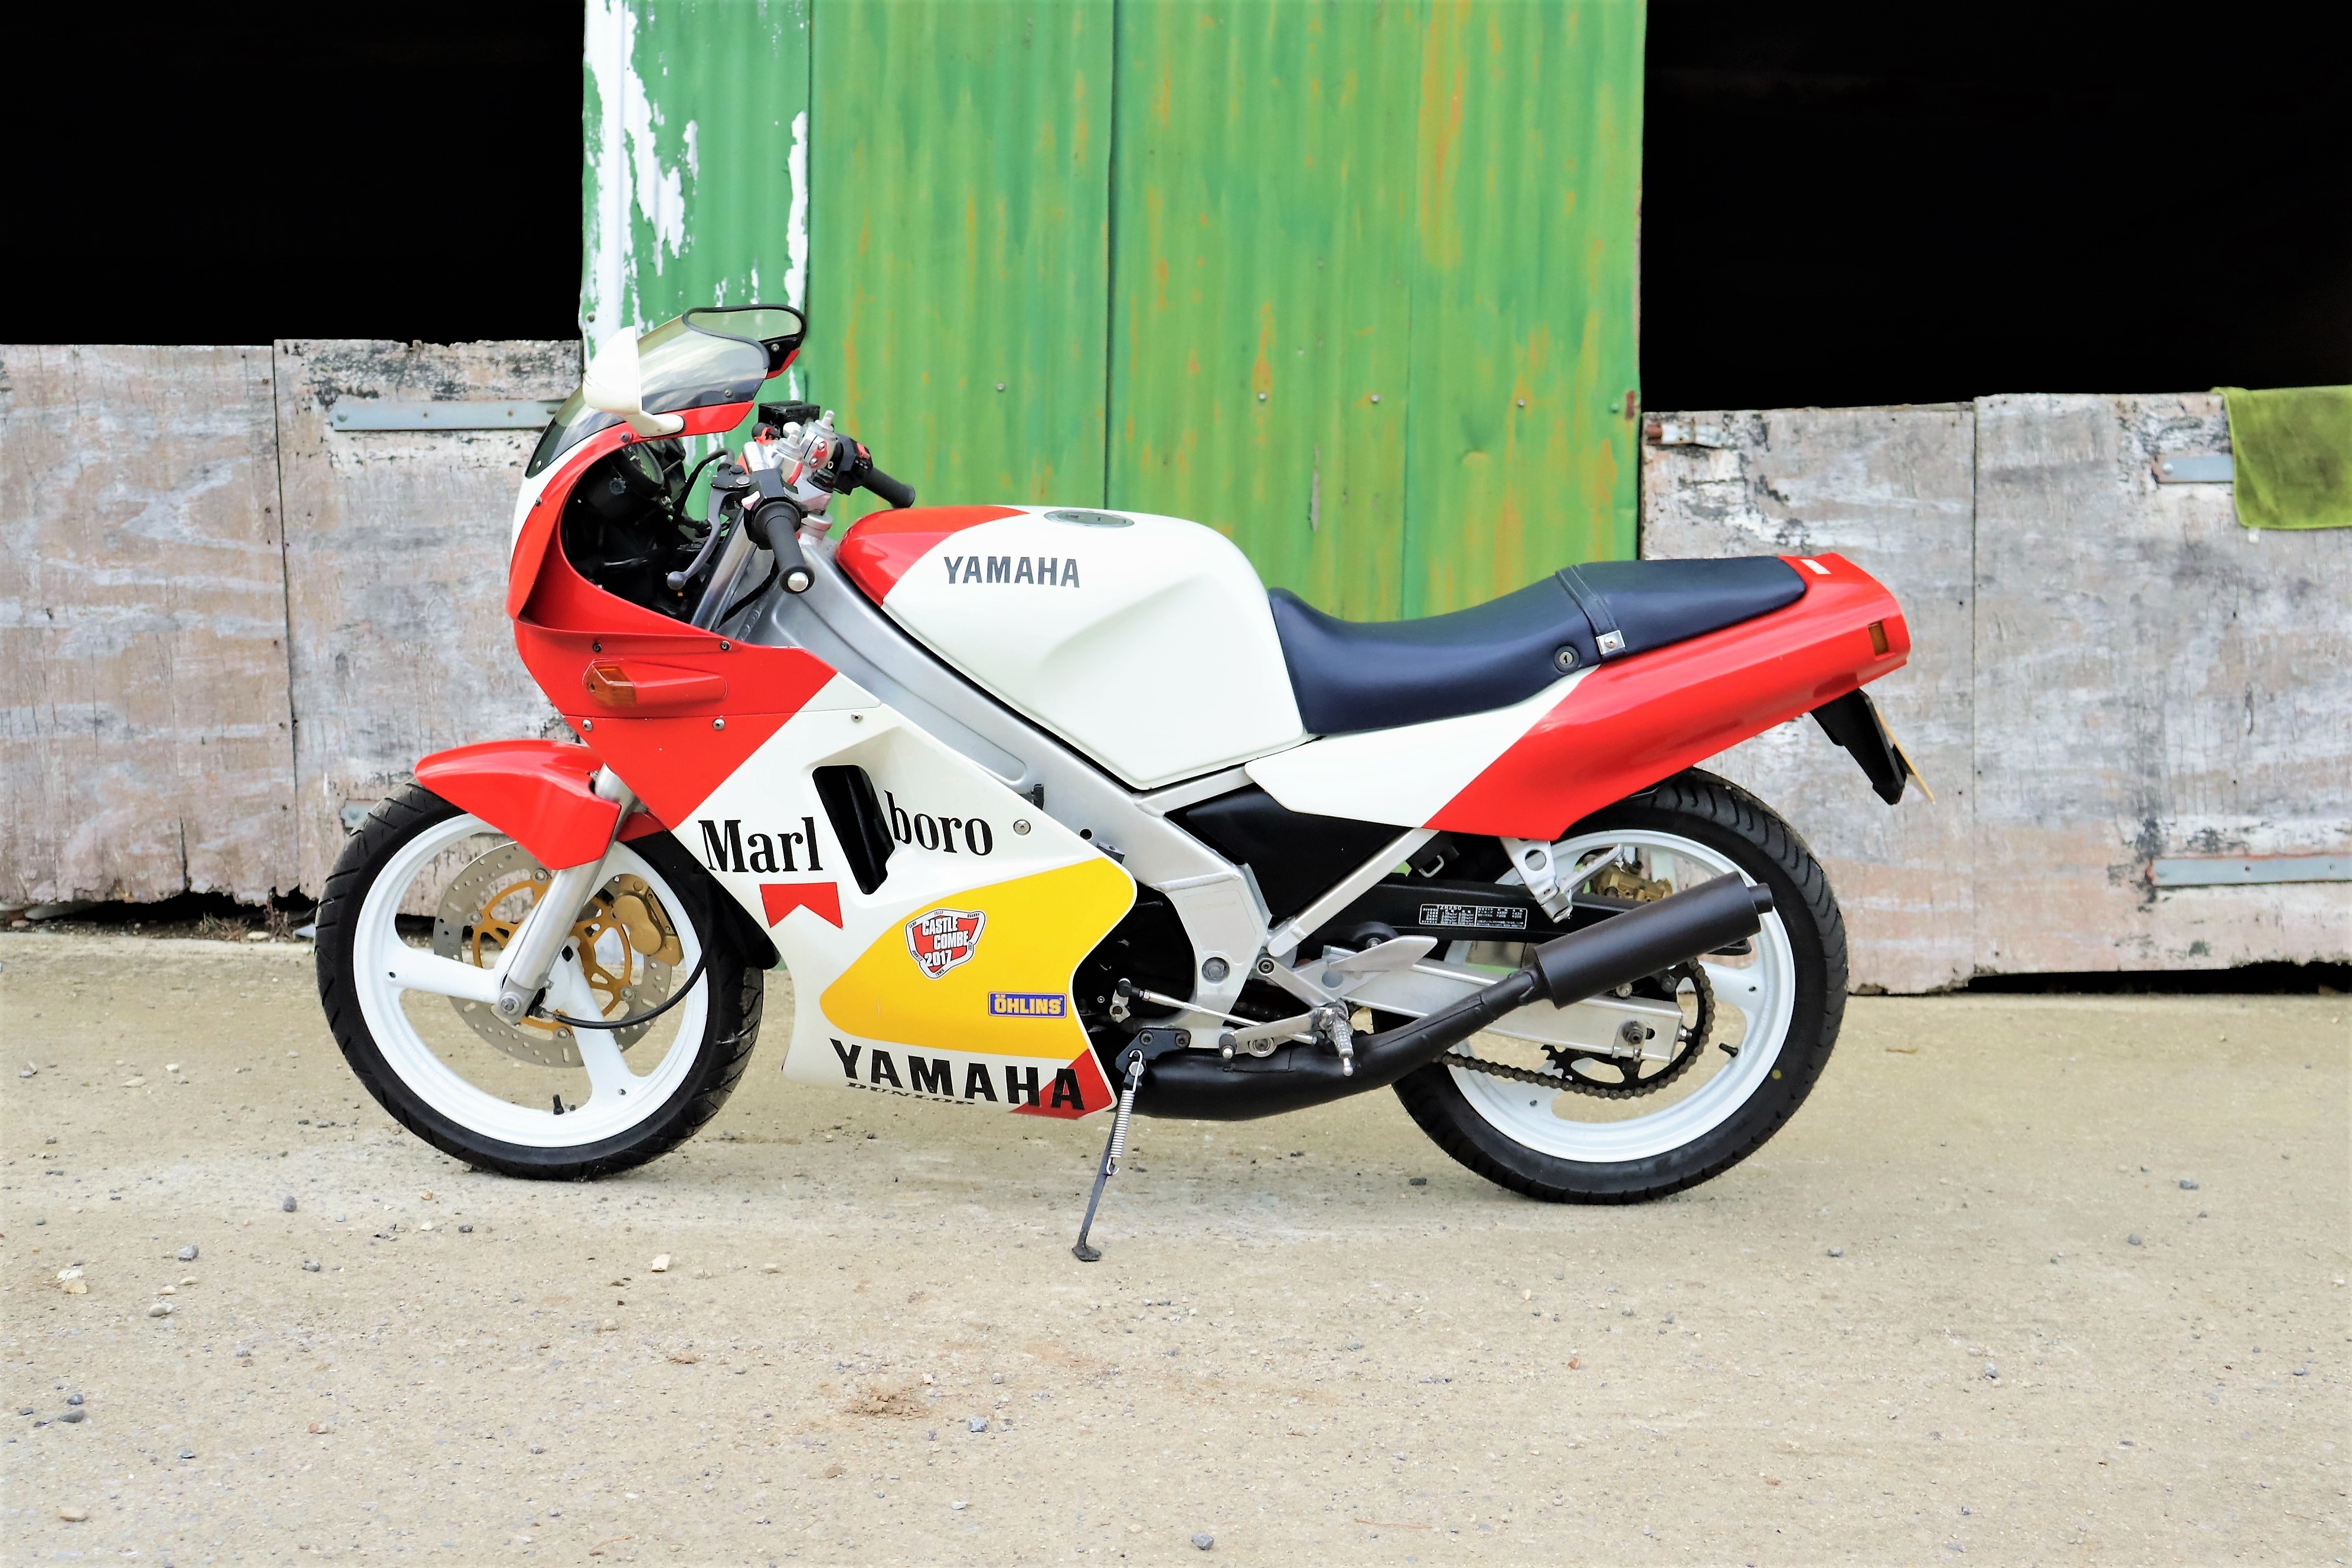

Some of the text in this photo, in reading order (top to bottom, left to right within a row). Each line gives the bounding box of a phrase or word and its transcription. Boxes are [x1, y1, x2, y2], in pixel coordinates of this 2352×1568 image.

[943, 556, 1080, 588] YAMAHA
[698, 790, 994, 873] Marl boro
[922, 916, 958, 936] CASTLE
[933, 930, 969, 950] COMBE
[924, 949, 953, 967] 2017
[994, 994, 1061, 1015] ÖHLINS
[829, 1037, 1085, 1110] YAMAHA
